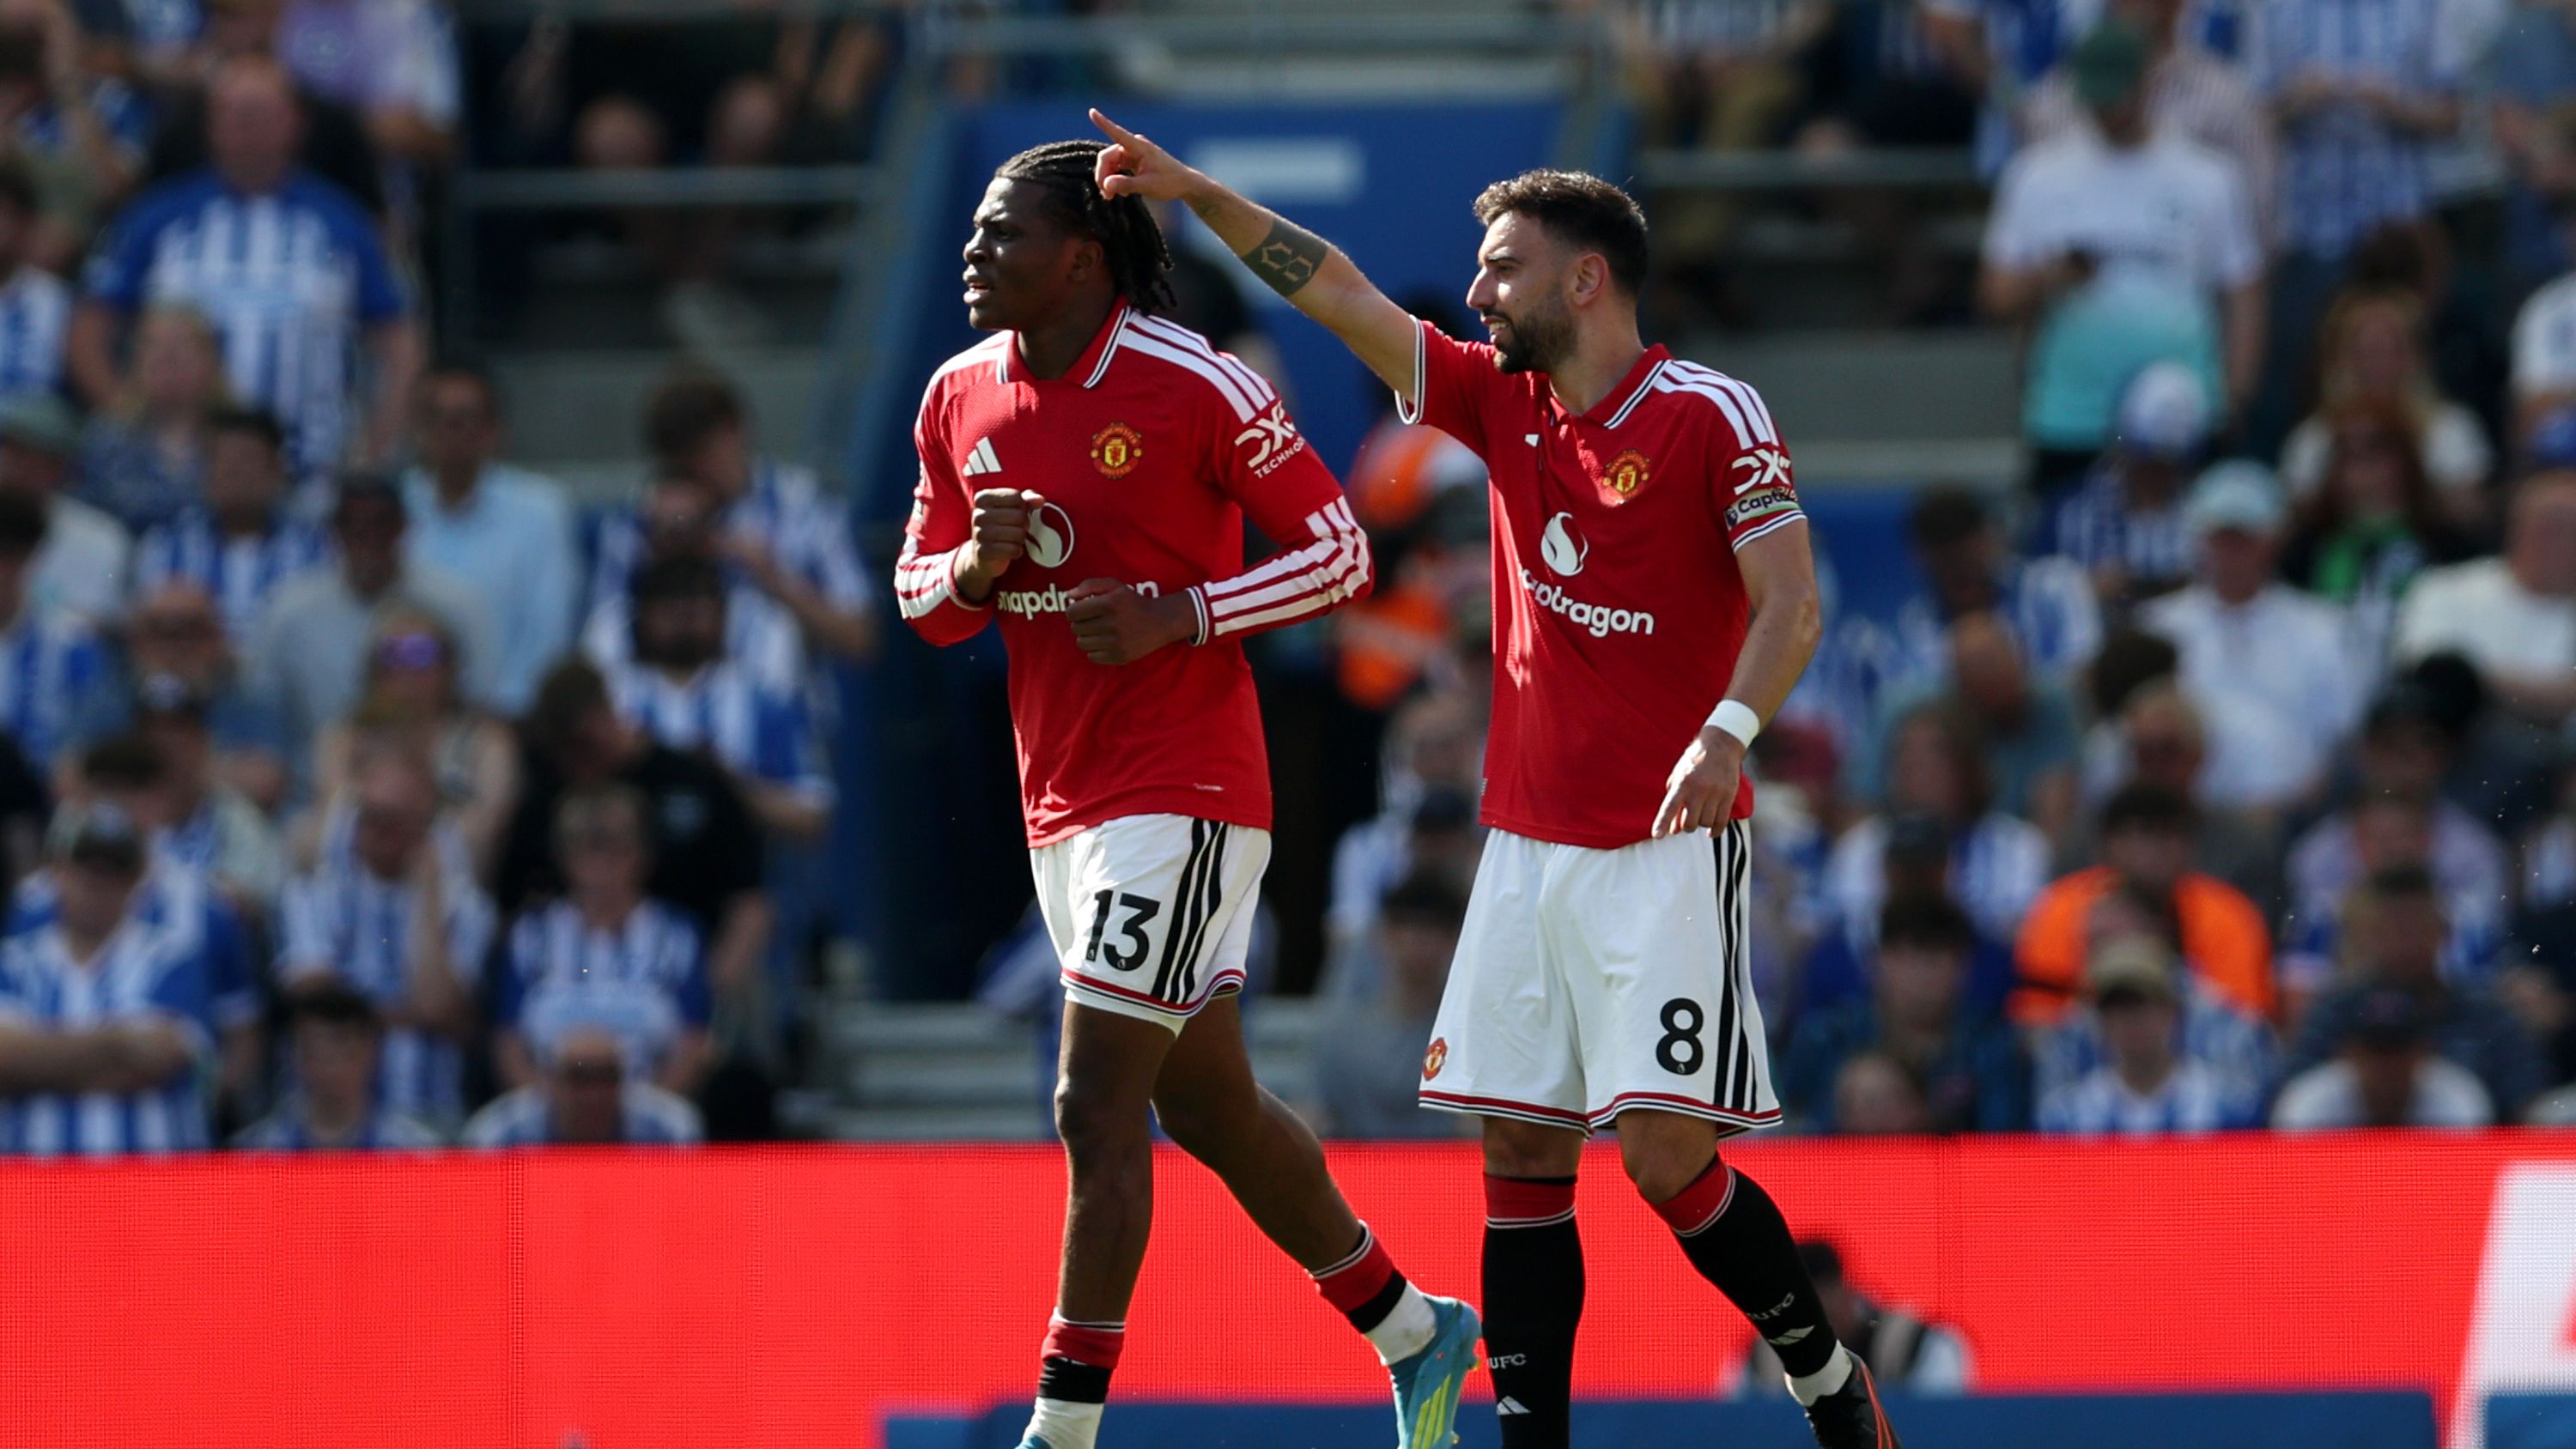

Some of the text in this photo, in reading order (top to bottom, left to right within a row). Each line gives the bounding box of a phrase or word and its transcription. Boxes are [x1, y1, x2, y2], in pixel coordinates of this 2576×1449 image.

[1085, 889, 1161, 972] 13
[1656, 997, 1704, 1076] 8
[1487, 1353, 1527, 1369] UFC
